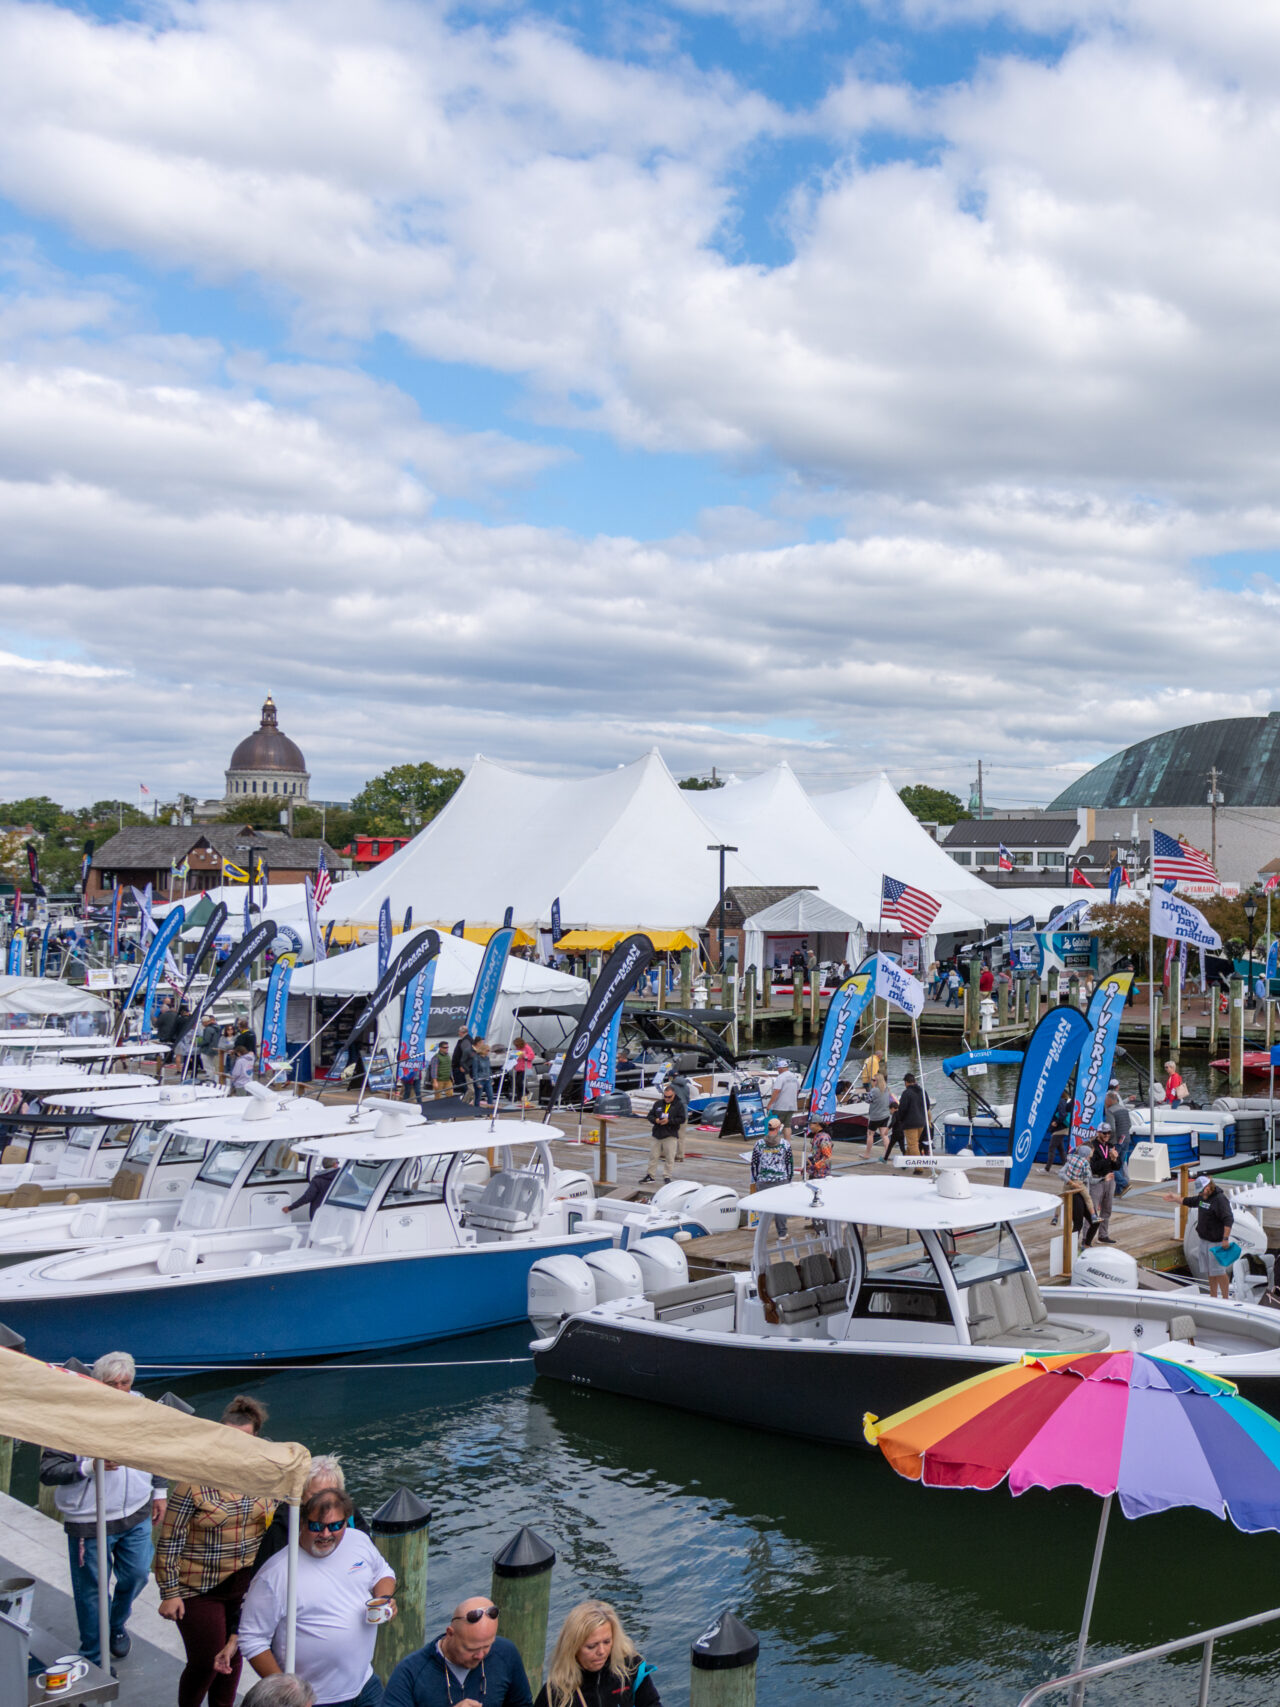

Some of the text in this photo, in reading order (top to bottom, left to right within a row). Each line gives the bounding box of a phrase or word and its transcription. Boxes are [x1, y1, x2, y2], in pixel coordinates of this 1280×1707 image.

[1161, 900, 1192, 917] north
[1190, 885, 1215, 893] YAMAHA
[1175, 925, 1215, 946] marina
[1177, 913, 1200, 931] bay
[216, 926, 268, 991] SPORTSMAN
[475, 945, 498, 1023] STARCRAFT
[588, 944, 638, 1032] SPORTSMAN
[272, 958, 290, 1057] RIVERSIDE
[408, 968, 427, 1058] VERSIDE
[429, 1006, 469, 1015] TARCR
[817, 983, 858, 1110] RIVERSIDE
[1053, 1023, 1072, 1063] BOATS
[1080, 981, 1121, 1125] RIVERSIDE
[589, 1080, 613, 1091] MARINE
[1028, 1017, 1067, 1128] SPORTSMAN
[1072, 1126, 1098, 1139] MARIN
[1086, 1267, 1128, 1284] MERCURY
